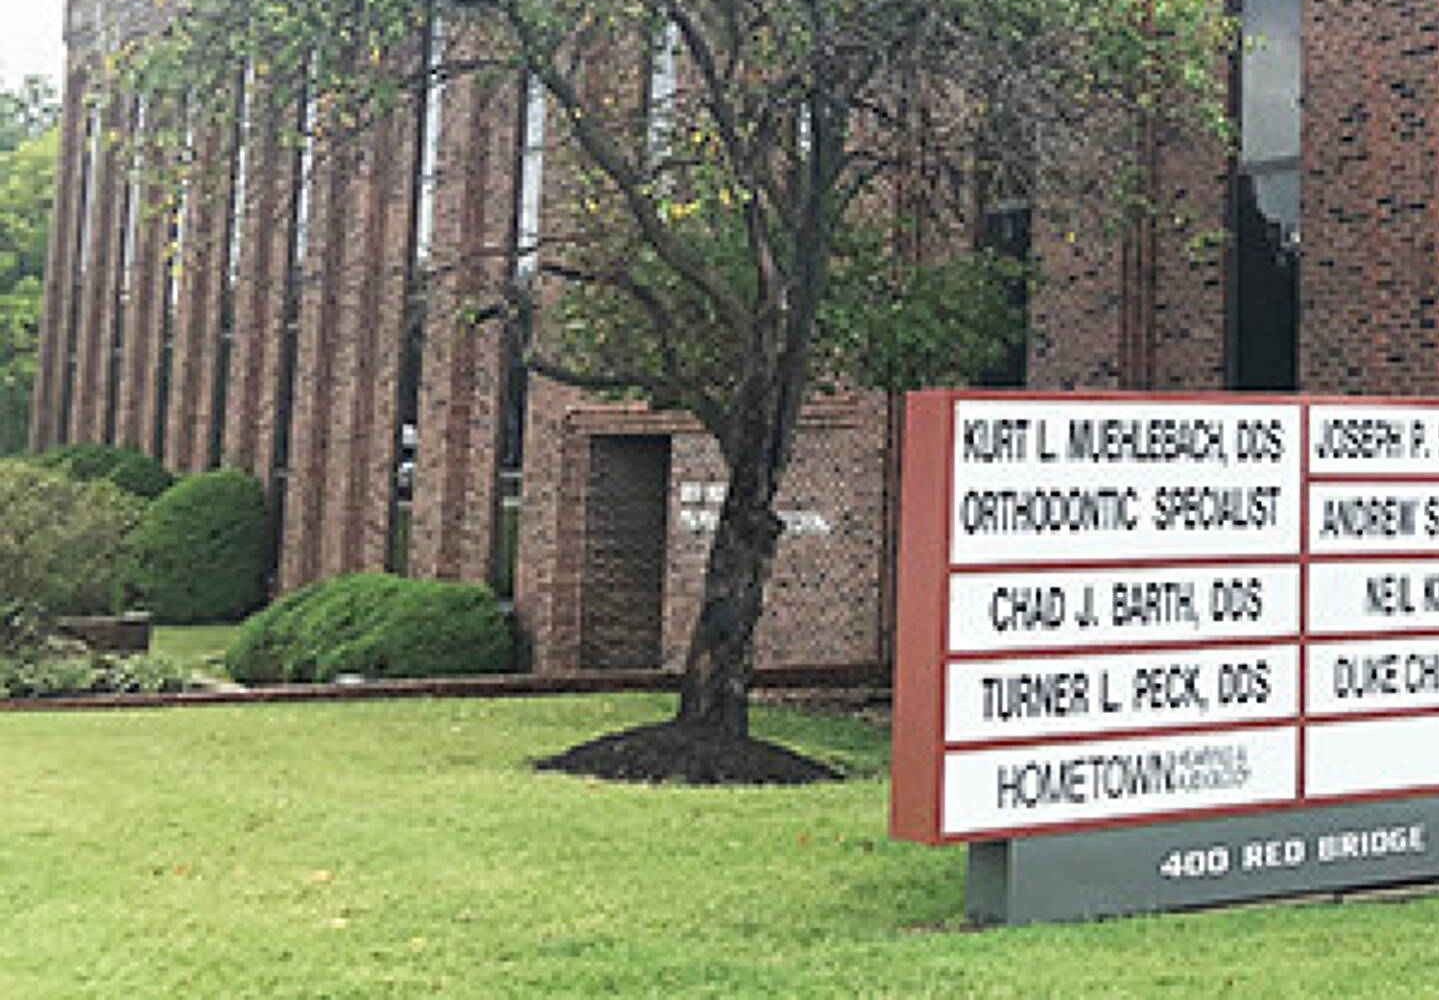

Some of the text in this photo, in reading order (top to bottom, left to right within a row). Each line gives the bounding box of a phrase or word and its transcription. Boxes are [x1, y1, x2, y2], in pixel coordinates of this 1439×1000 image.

[962, 419, 1031, 462] KURT
[1066, 419, 1228, 467] MUEHLEBACH,
[1236, 419, 1284, 462] DDS
[1316, 419, 1405, 458] JOSEPH
[1410, 419, 1431, 458] P.
[960, 486, 1281, 534] ORTHODONTIC SPECIALIST
[1319, 496, 1419, 539] ANDREW
[989, 577, 1263, 632] CHAD J. BARTH, DDS
[1364, 573, 1415, 615] NEIL
[980, 673, 1089, 722] TURNER
[1132, 663, 1208, 712] PECK,
[1217, 658, 1271, 704] DDS
[1333, 654, 1398, 697] DUKE
[997, 752, 1177, 809] HOMETOWN
[1160, 824, 1425, 878] 400 RED BRIDGE
